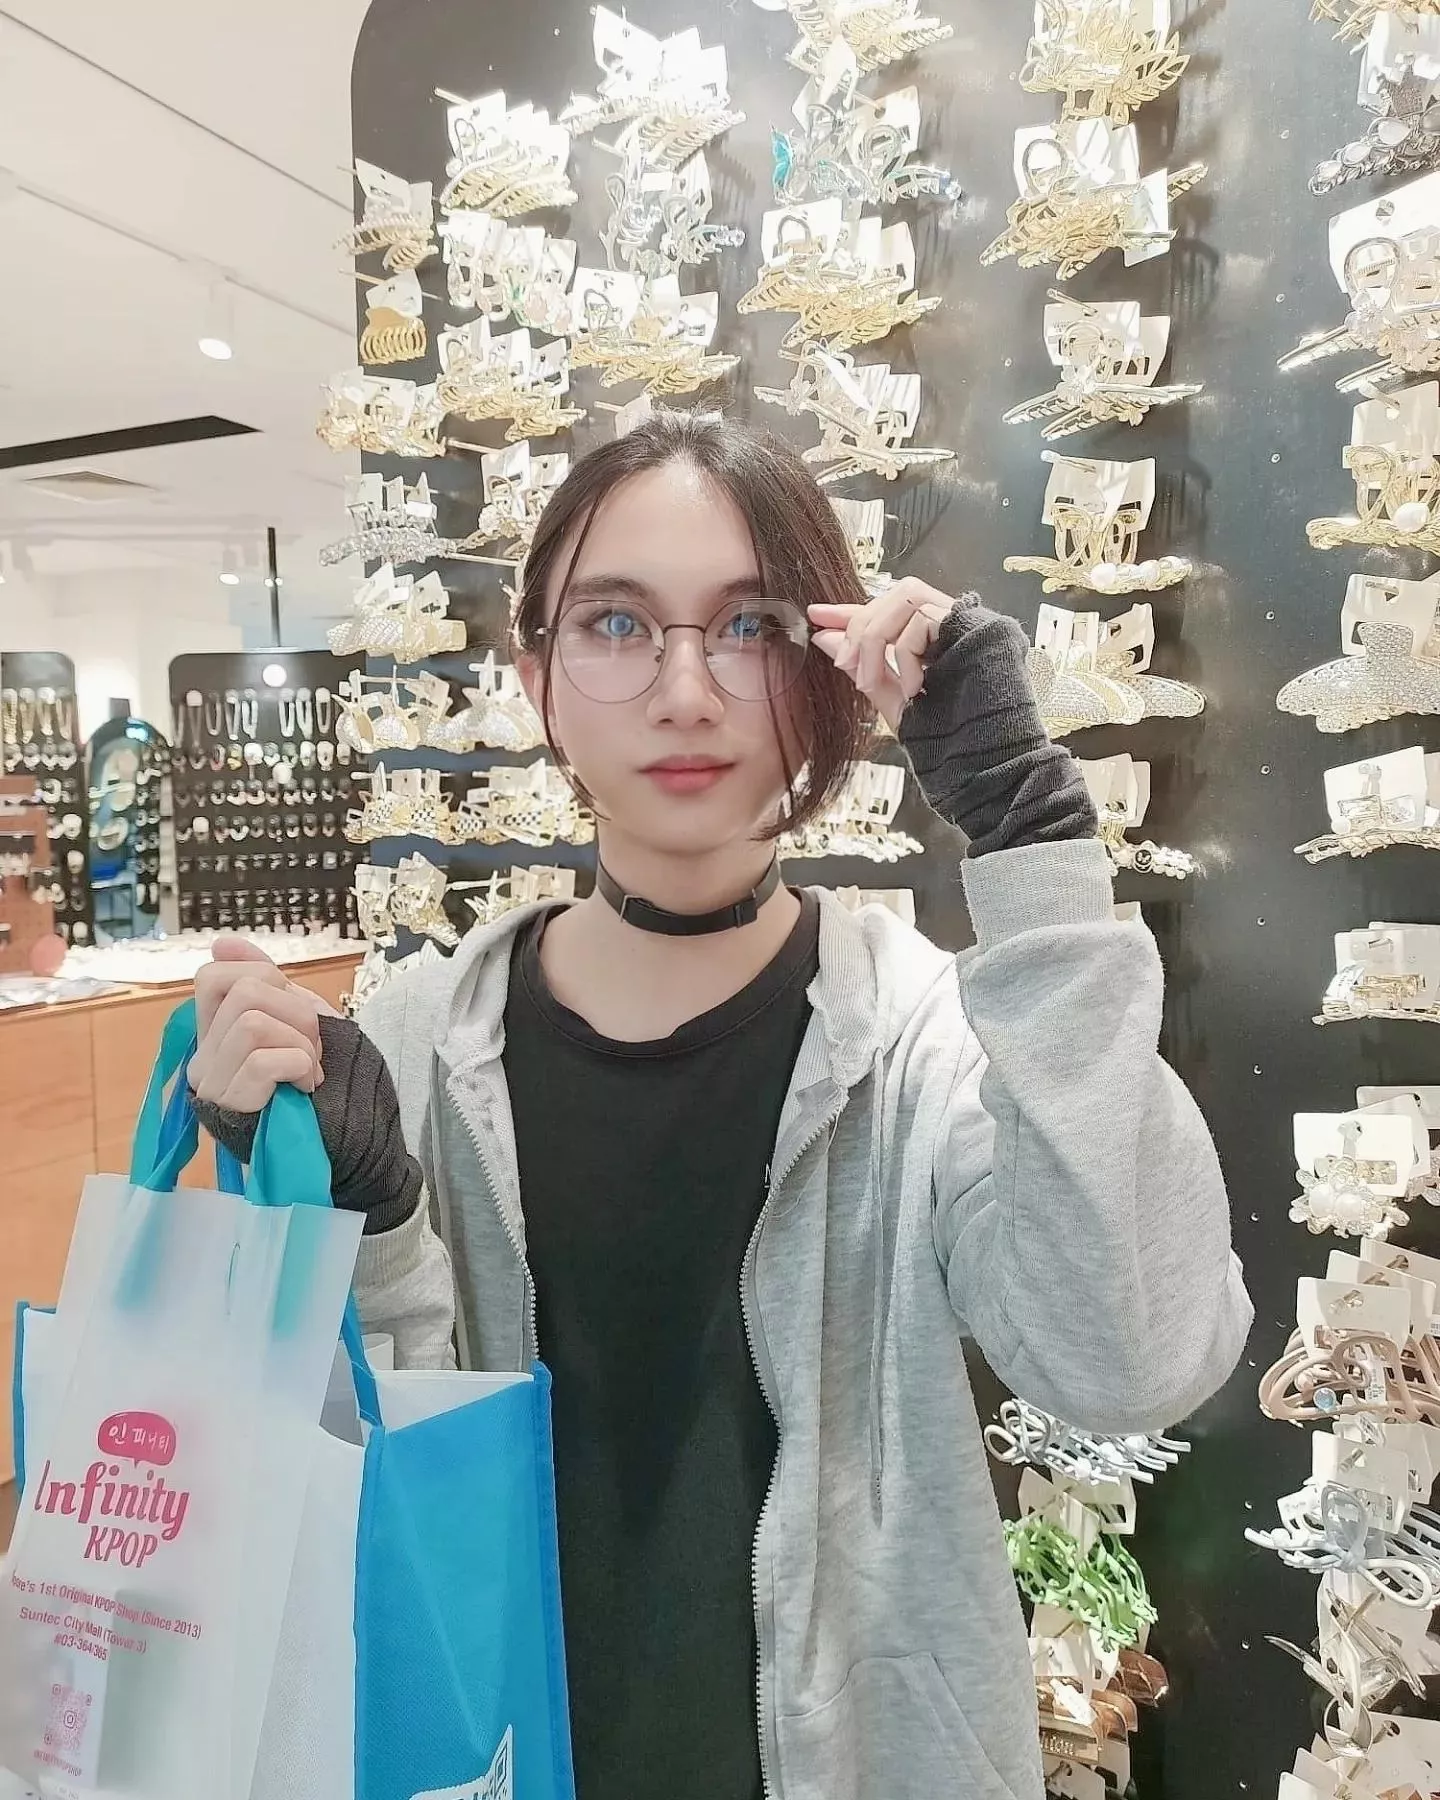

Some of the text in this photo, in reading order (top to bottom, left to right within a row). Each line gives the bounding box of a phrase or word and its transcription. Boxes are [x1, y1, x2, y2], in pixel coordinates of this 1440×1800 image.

[34, 1459, 190, 1541] Infinity
[83, 1525, 159, 1568] KPOP
[19, 1606, 61, 1626] Suntec
[63, 1615, 86, 1634] City
[39, 1582, 57, 1597] 1st
[58, 1584, 94, 1607] Original
[94, 1594, 116, 1613] KPOP
[116, 1604, 142, 1624] Shop
[141, 1608, 172, 1632] (Since
[173, 1619, 202, 1640] 2013)
